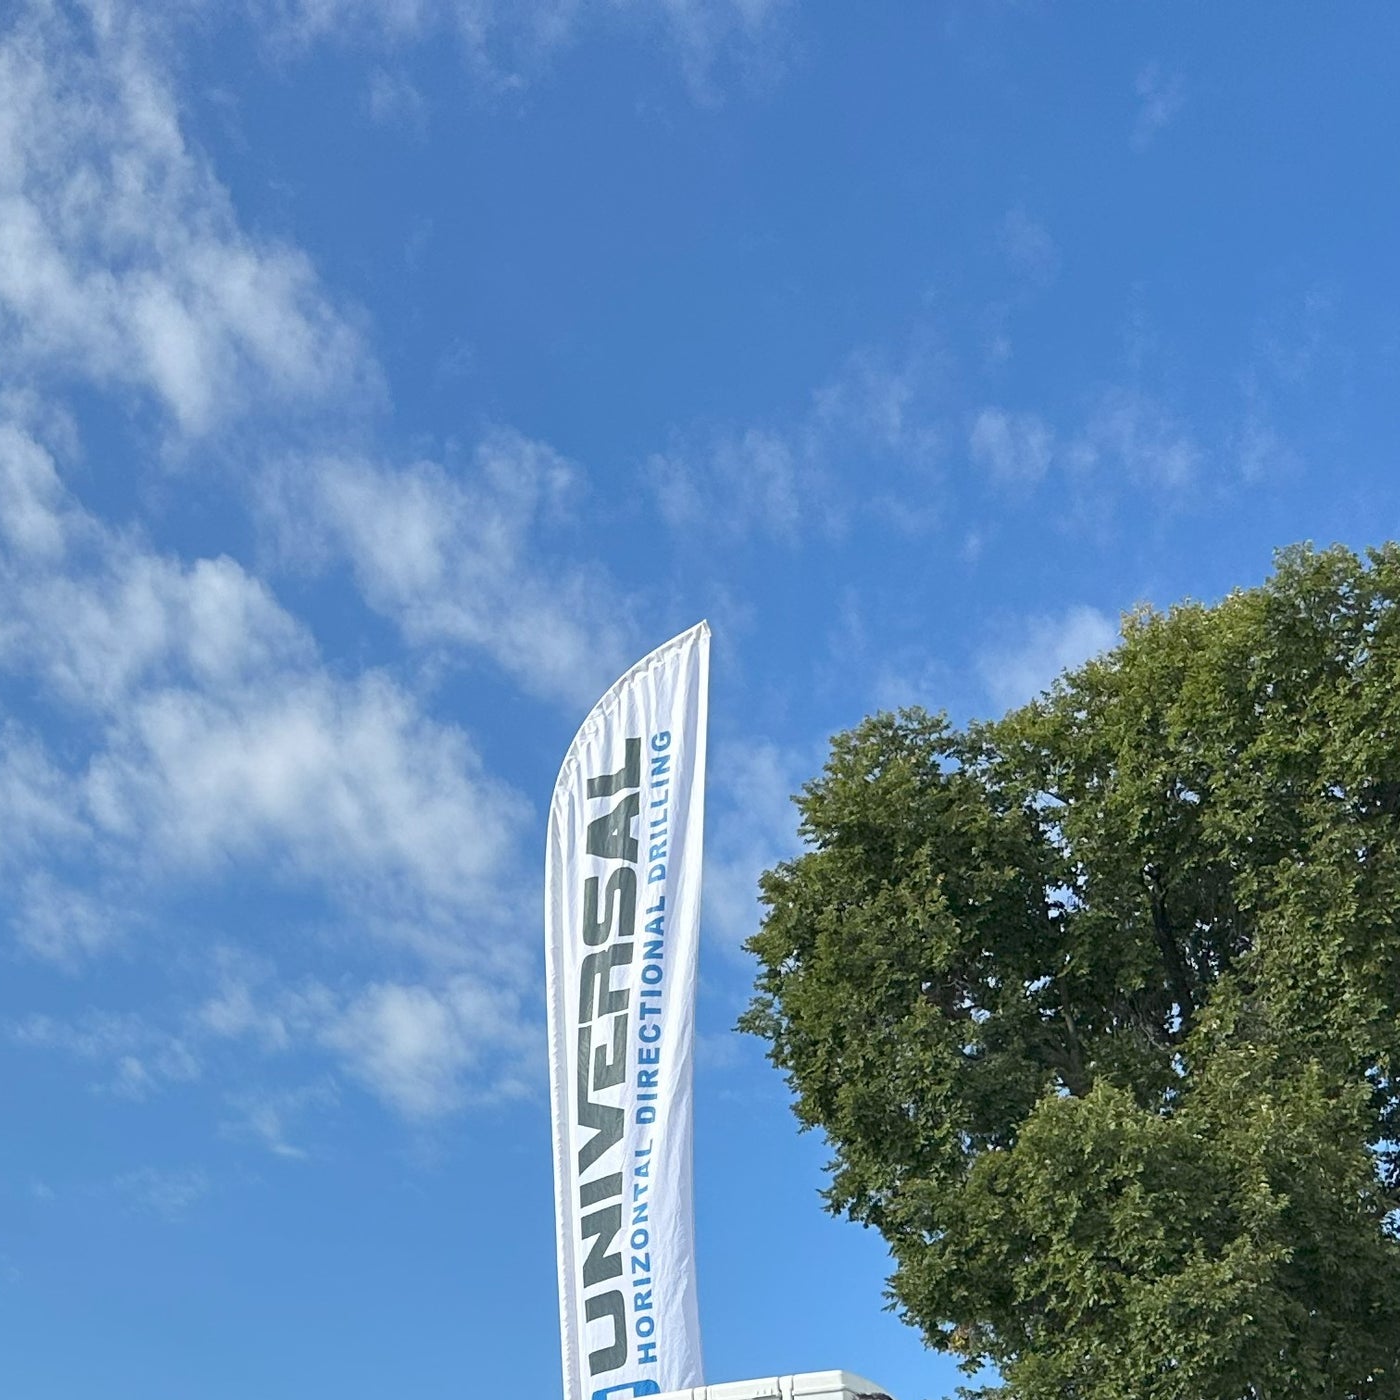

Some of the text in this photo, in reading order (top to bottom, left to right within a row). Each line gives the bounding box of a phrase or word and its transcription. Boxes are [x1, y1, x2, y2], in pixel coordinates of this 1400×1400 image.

[577, 738, 641, 1376] UNIVERSAL
[630, 730, 672, 1364] HORIZONTAL DIRECTIONAL DRILLING
